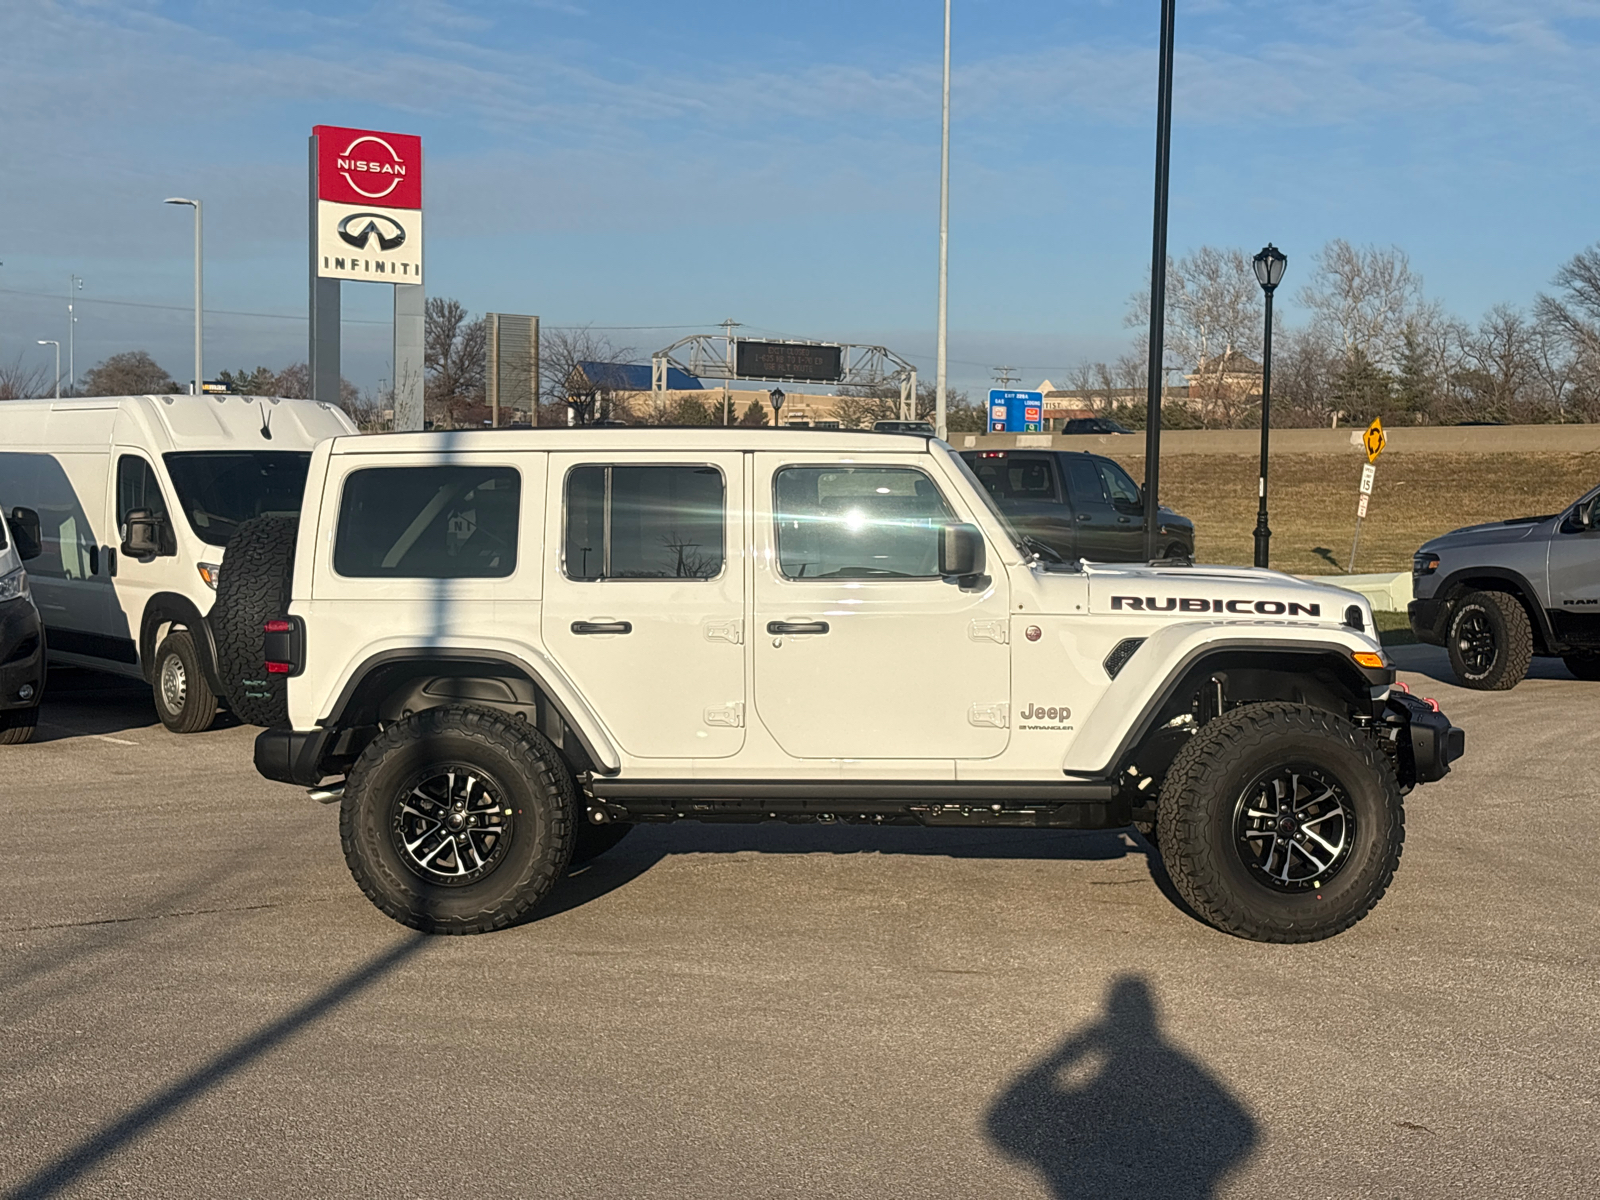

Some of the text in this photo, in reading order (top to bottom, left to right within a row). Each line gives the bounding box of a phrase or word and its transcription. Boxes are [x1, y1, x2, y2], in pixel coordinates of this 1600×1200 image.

[337, 158, 406, 175] NISSAN
[323, 256, 420, 276] INFINITI
[787, 348, 810, 356] CLOSED
[1363, 480, 1370, 491] 15
[1110, 595, 1321, 617] RUBICON
[1020, 702, 1071, 723] Jeep
